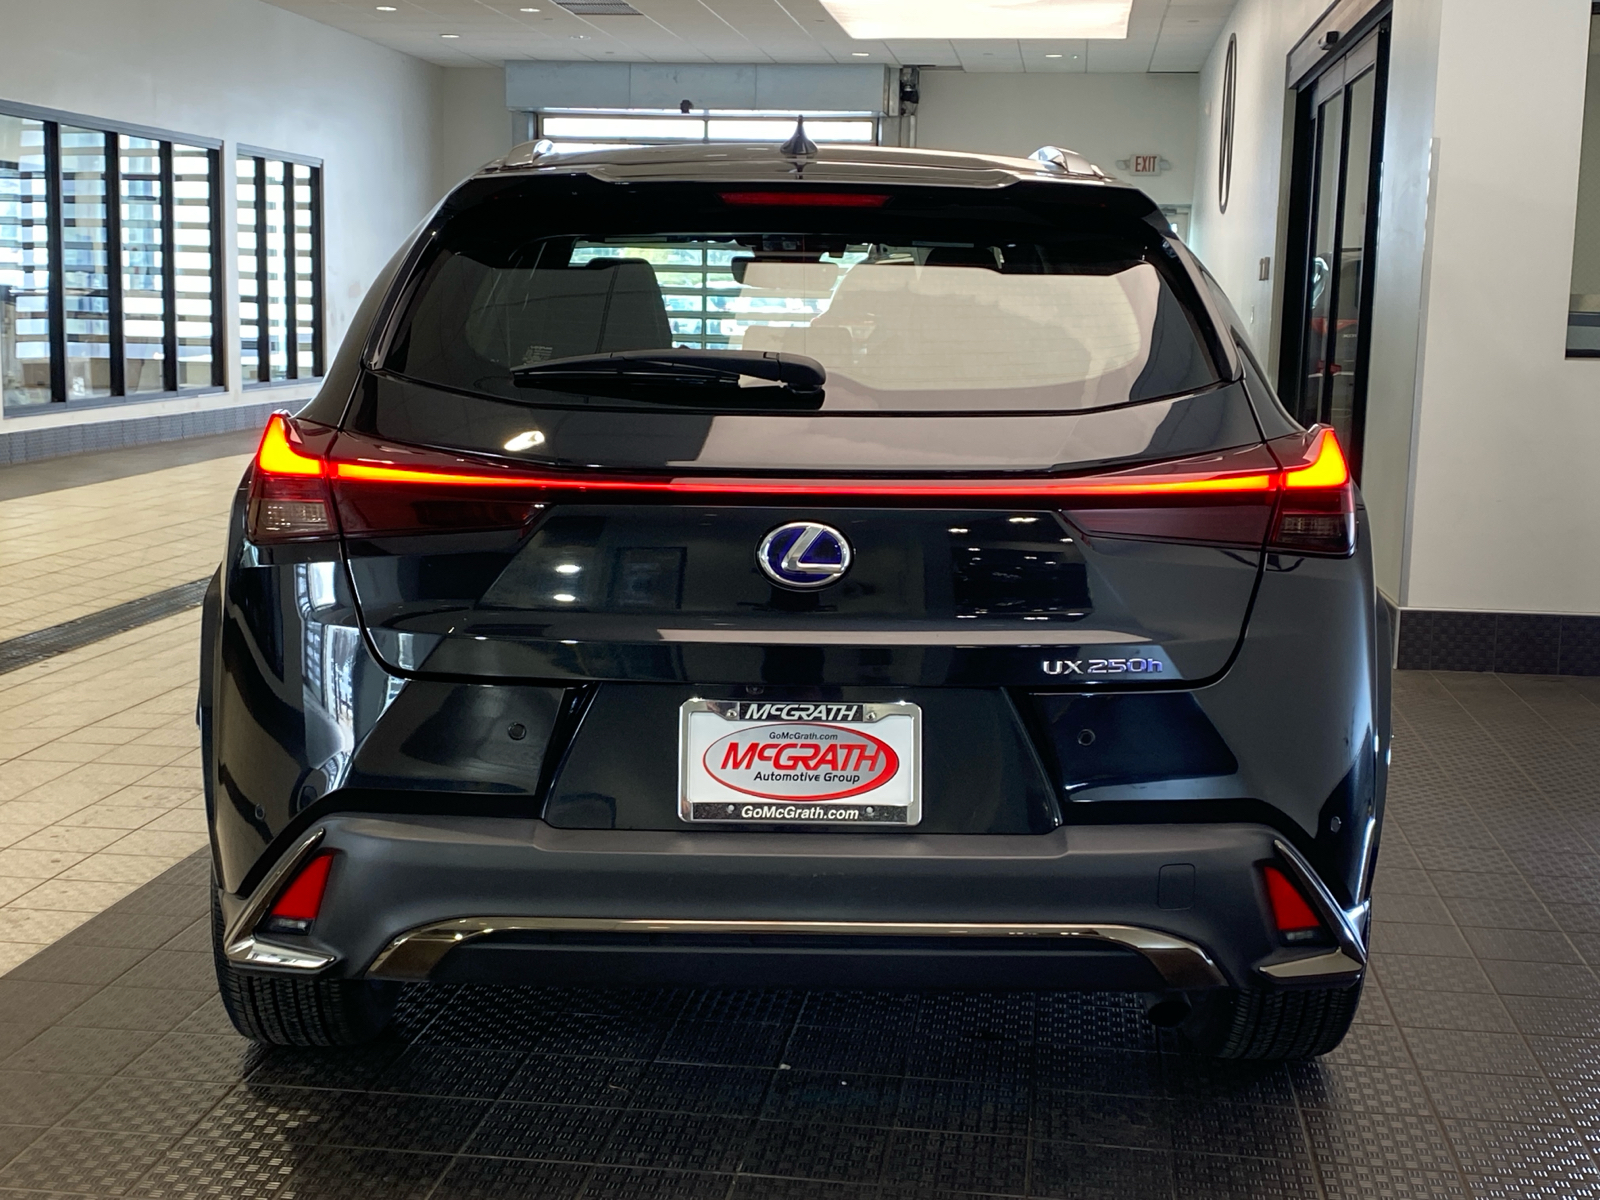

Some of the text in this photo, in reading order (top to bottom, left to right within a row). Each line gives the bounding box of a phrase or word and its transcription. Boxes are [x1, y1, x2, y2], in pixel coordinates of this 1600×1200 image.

[1135, 156, 1157, 172] EXIT
[1043, 658, 1163, 675] UX 250h
[769, 731, 838, 741] GoMcGrath.com
[753, 771, 860, 785] Automotive Group
[741, 805, 859, 820] GoMcGrath.com
